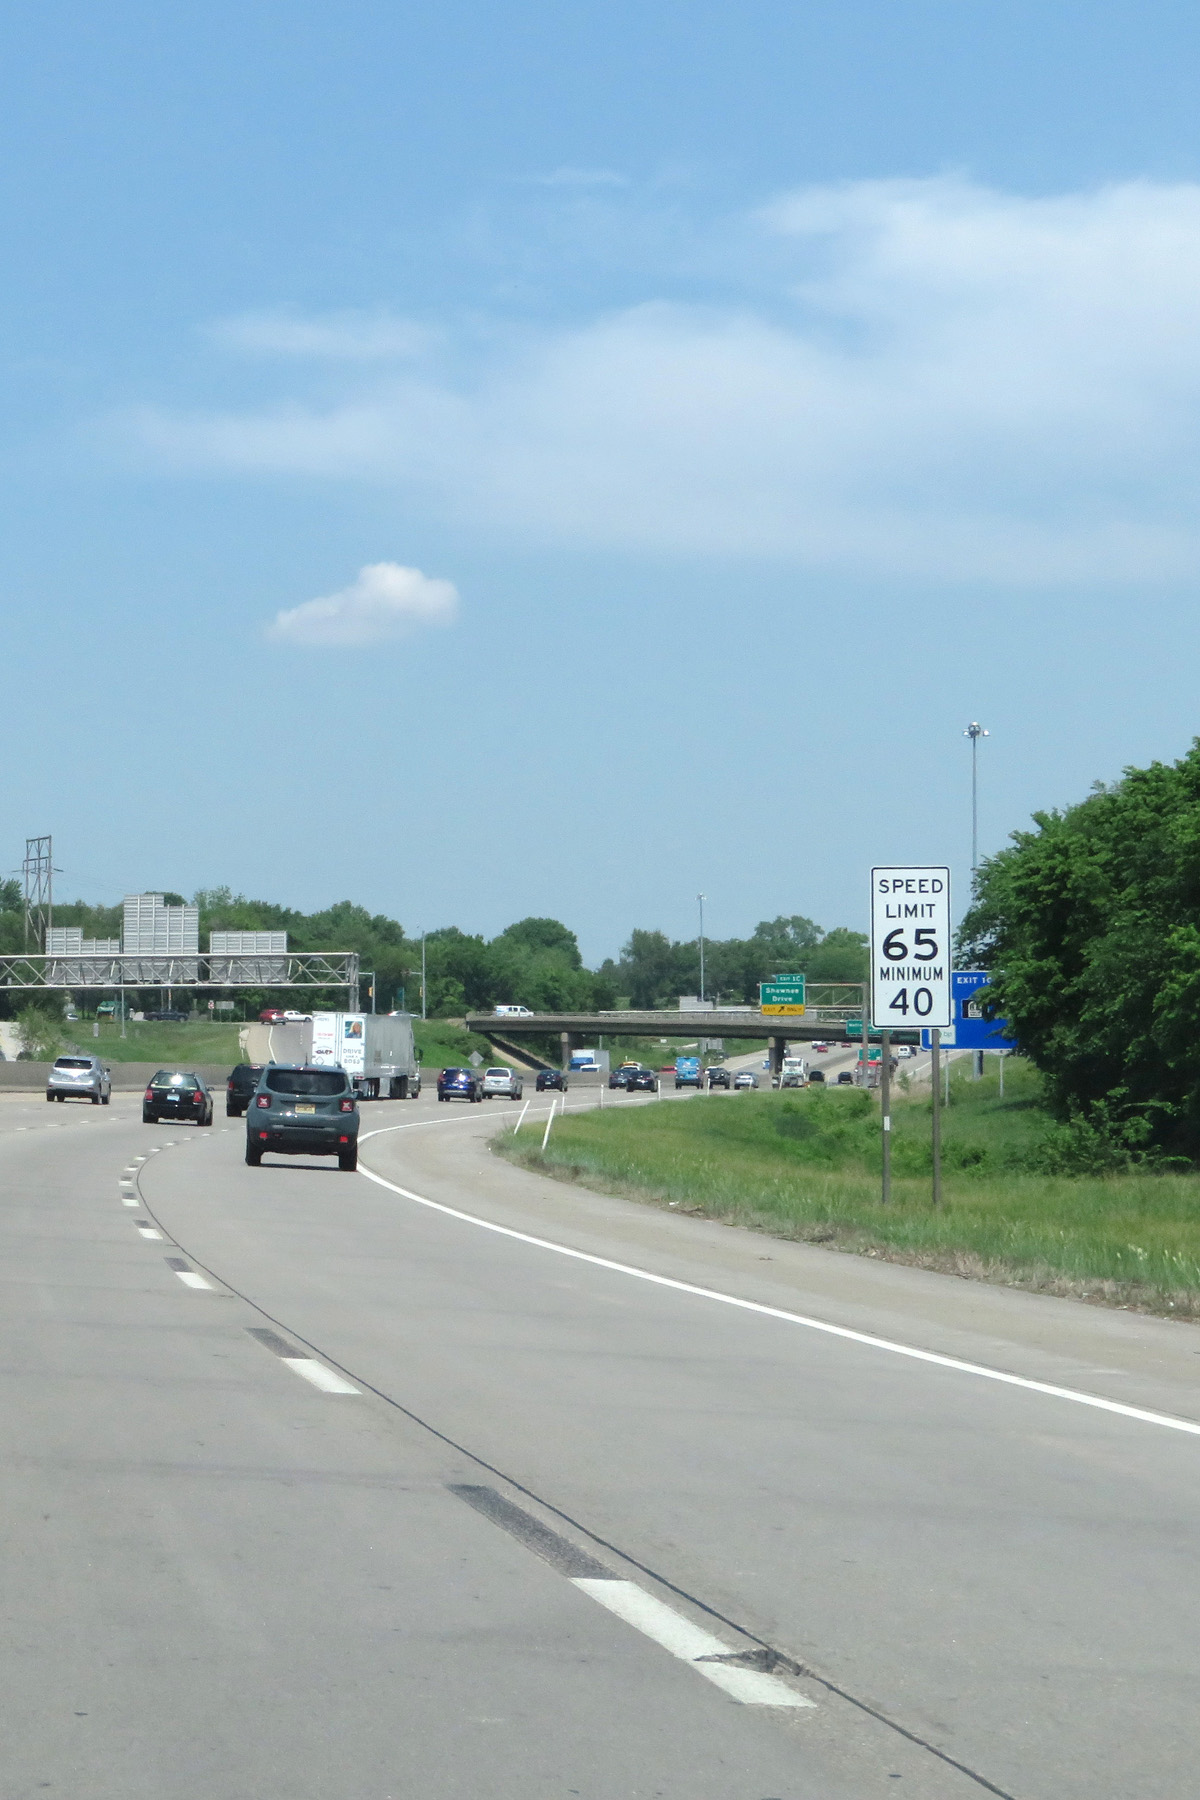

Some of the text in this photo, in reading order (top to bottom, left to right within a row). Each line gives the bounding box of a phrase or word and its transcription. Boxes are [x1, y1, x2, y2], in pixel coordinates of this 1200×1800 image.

[878, 879, 944, 894] SPEED
[885, 904, 936, 919] LIMIT
[882, 928, 939, 962] 65
[880, 966, 944, 982] MINIMUM
[956, 976, 979, 984] EXIT
[888, 987, 933, 1017] 40
